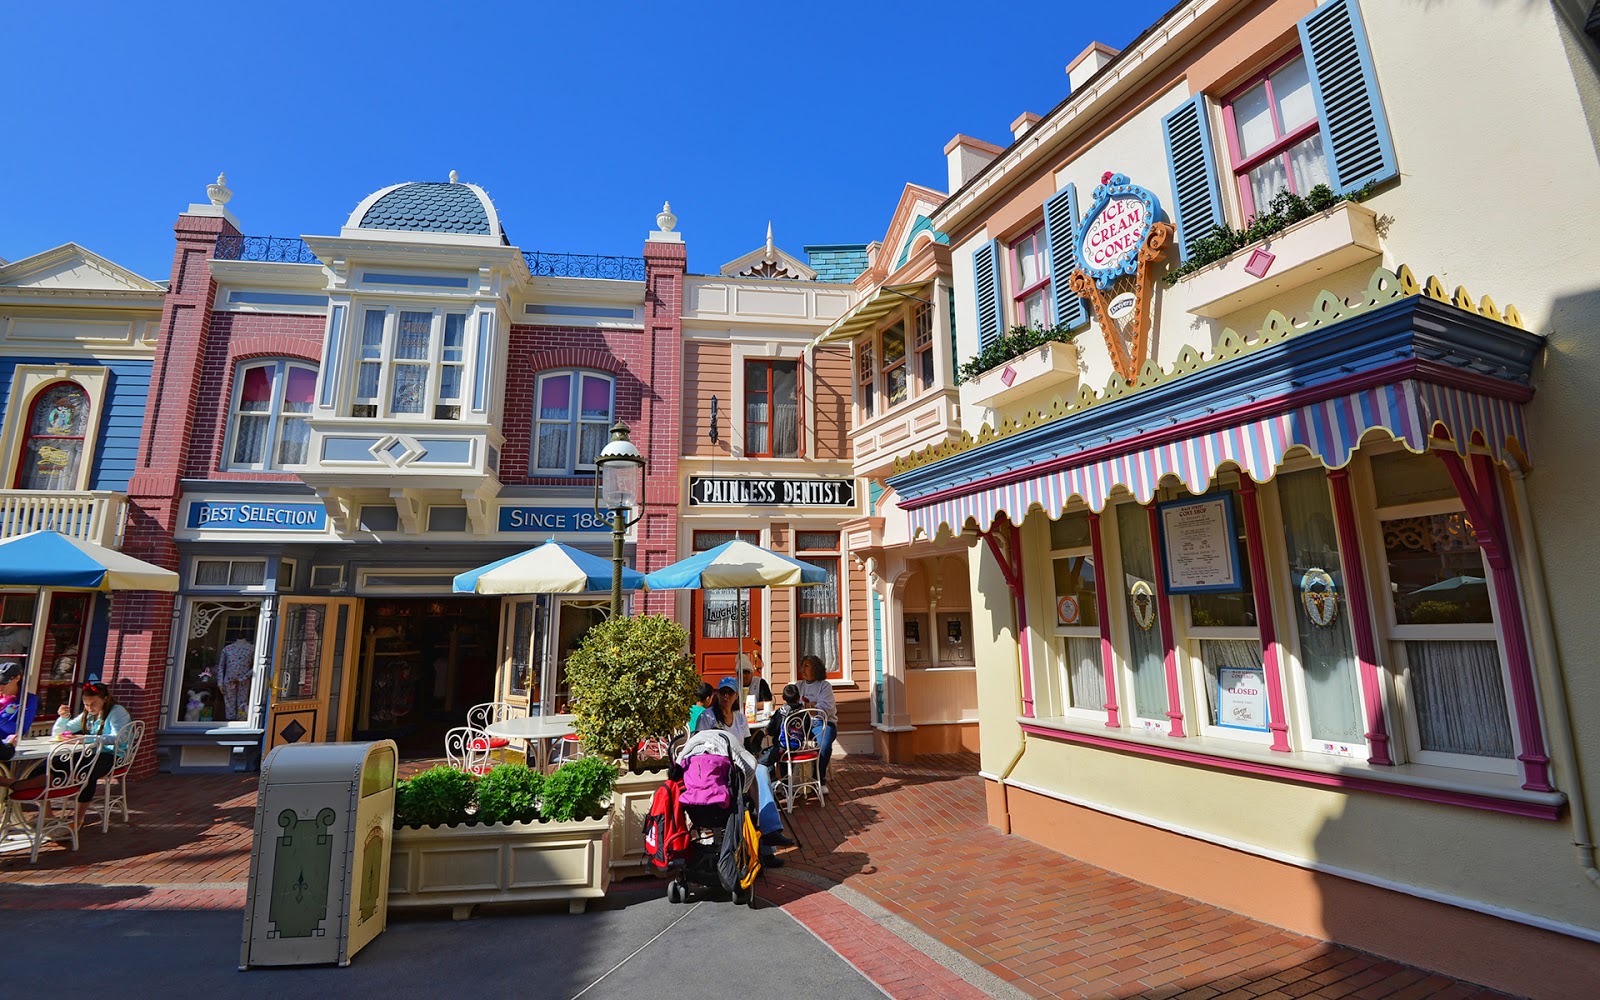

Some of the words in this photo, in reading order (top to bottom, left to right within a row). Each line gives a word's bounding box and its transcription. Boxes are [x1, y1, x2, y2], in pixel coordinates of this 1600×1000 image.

[1102, 200, 1125, 223] ICE
[1091, 209, 1140, 247] CREAM
[1094, 228, 1141, 264] CONES
[703, 479, 776, 503] PAINLESS
[783, 480, 841, 504] DENTIST
[198, 506, 236, 524] BEST
[238, 504, 318, 525] SELECTION
[510, 509, 566, 528] SINCE
[1228, 687, 1258, 696] CLOSED
